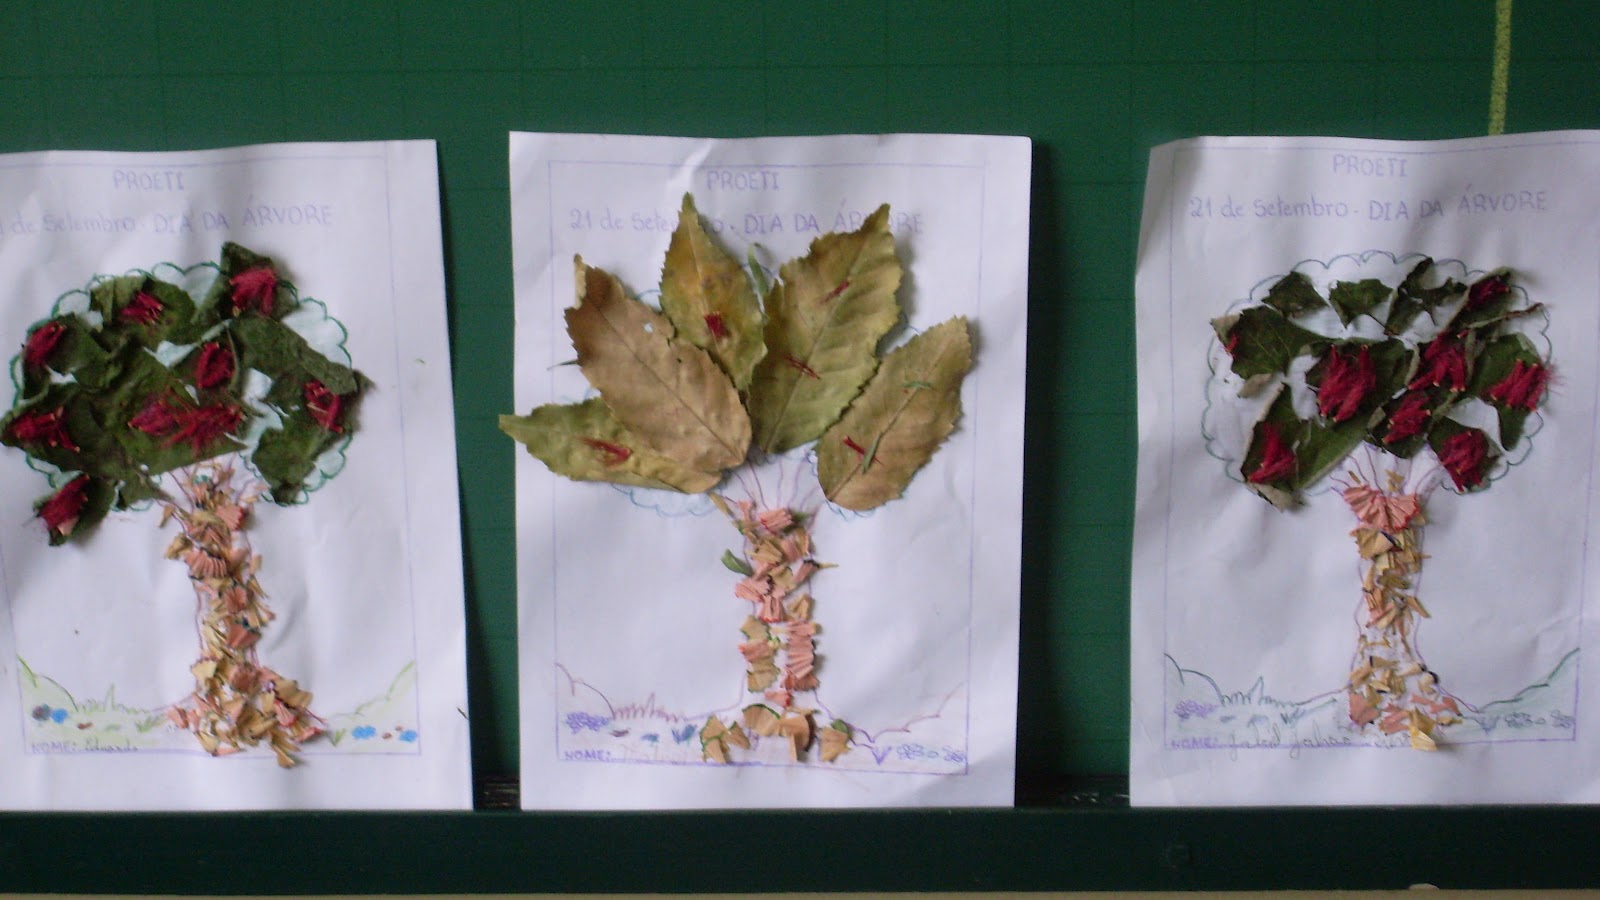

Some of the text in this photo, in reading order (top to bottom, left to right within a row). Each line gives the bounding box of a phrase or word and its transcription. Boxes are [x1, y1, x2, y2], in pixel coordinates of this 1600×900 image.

[1333, 154, 1408, 177] PROETI
[112, 169, 186, 192] PROETI
[706, 170, 780, 191] PROETI
[12, 210, 34, 234] de
[154, 211, 192, 234] DIA
[203, 209, 230, 231] DA
[241, 193, 333, 227] ÁRVORE
[1190, 200, 1213, 218] 21
[1221, 196, 1244, 219] de
[1255, 196, 1349, 219] Setembro
[1369, 200, 1409, 221] DIA
[1419, 199, 1445, 218] DA
[1458, 184, 1547, 214] ÁRVORE
[569, 208, 592, 231] 21
[600, 206, 624, 230] de
[744, 214, 783, 234] DIA
[794, 213, 819, 233] DA
[565, 749, 611, 762] NOME:
